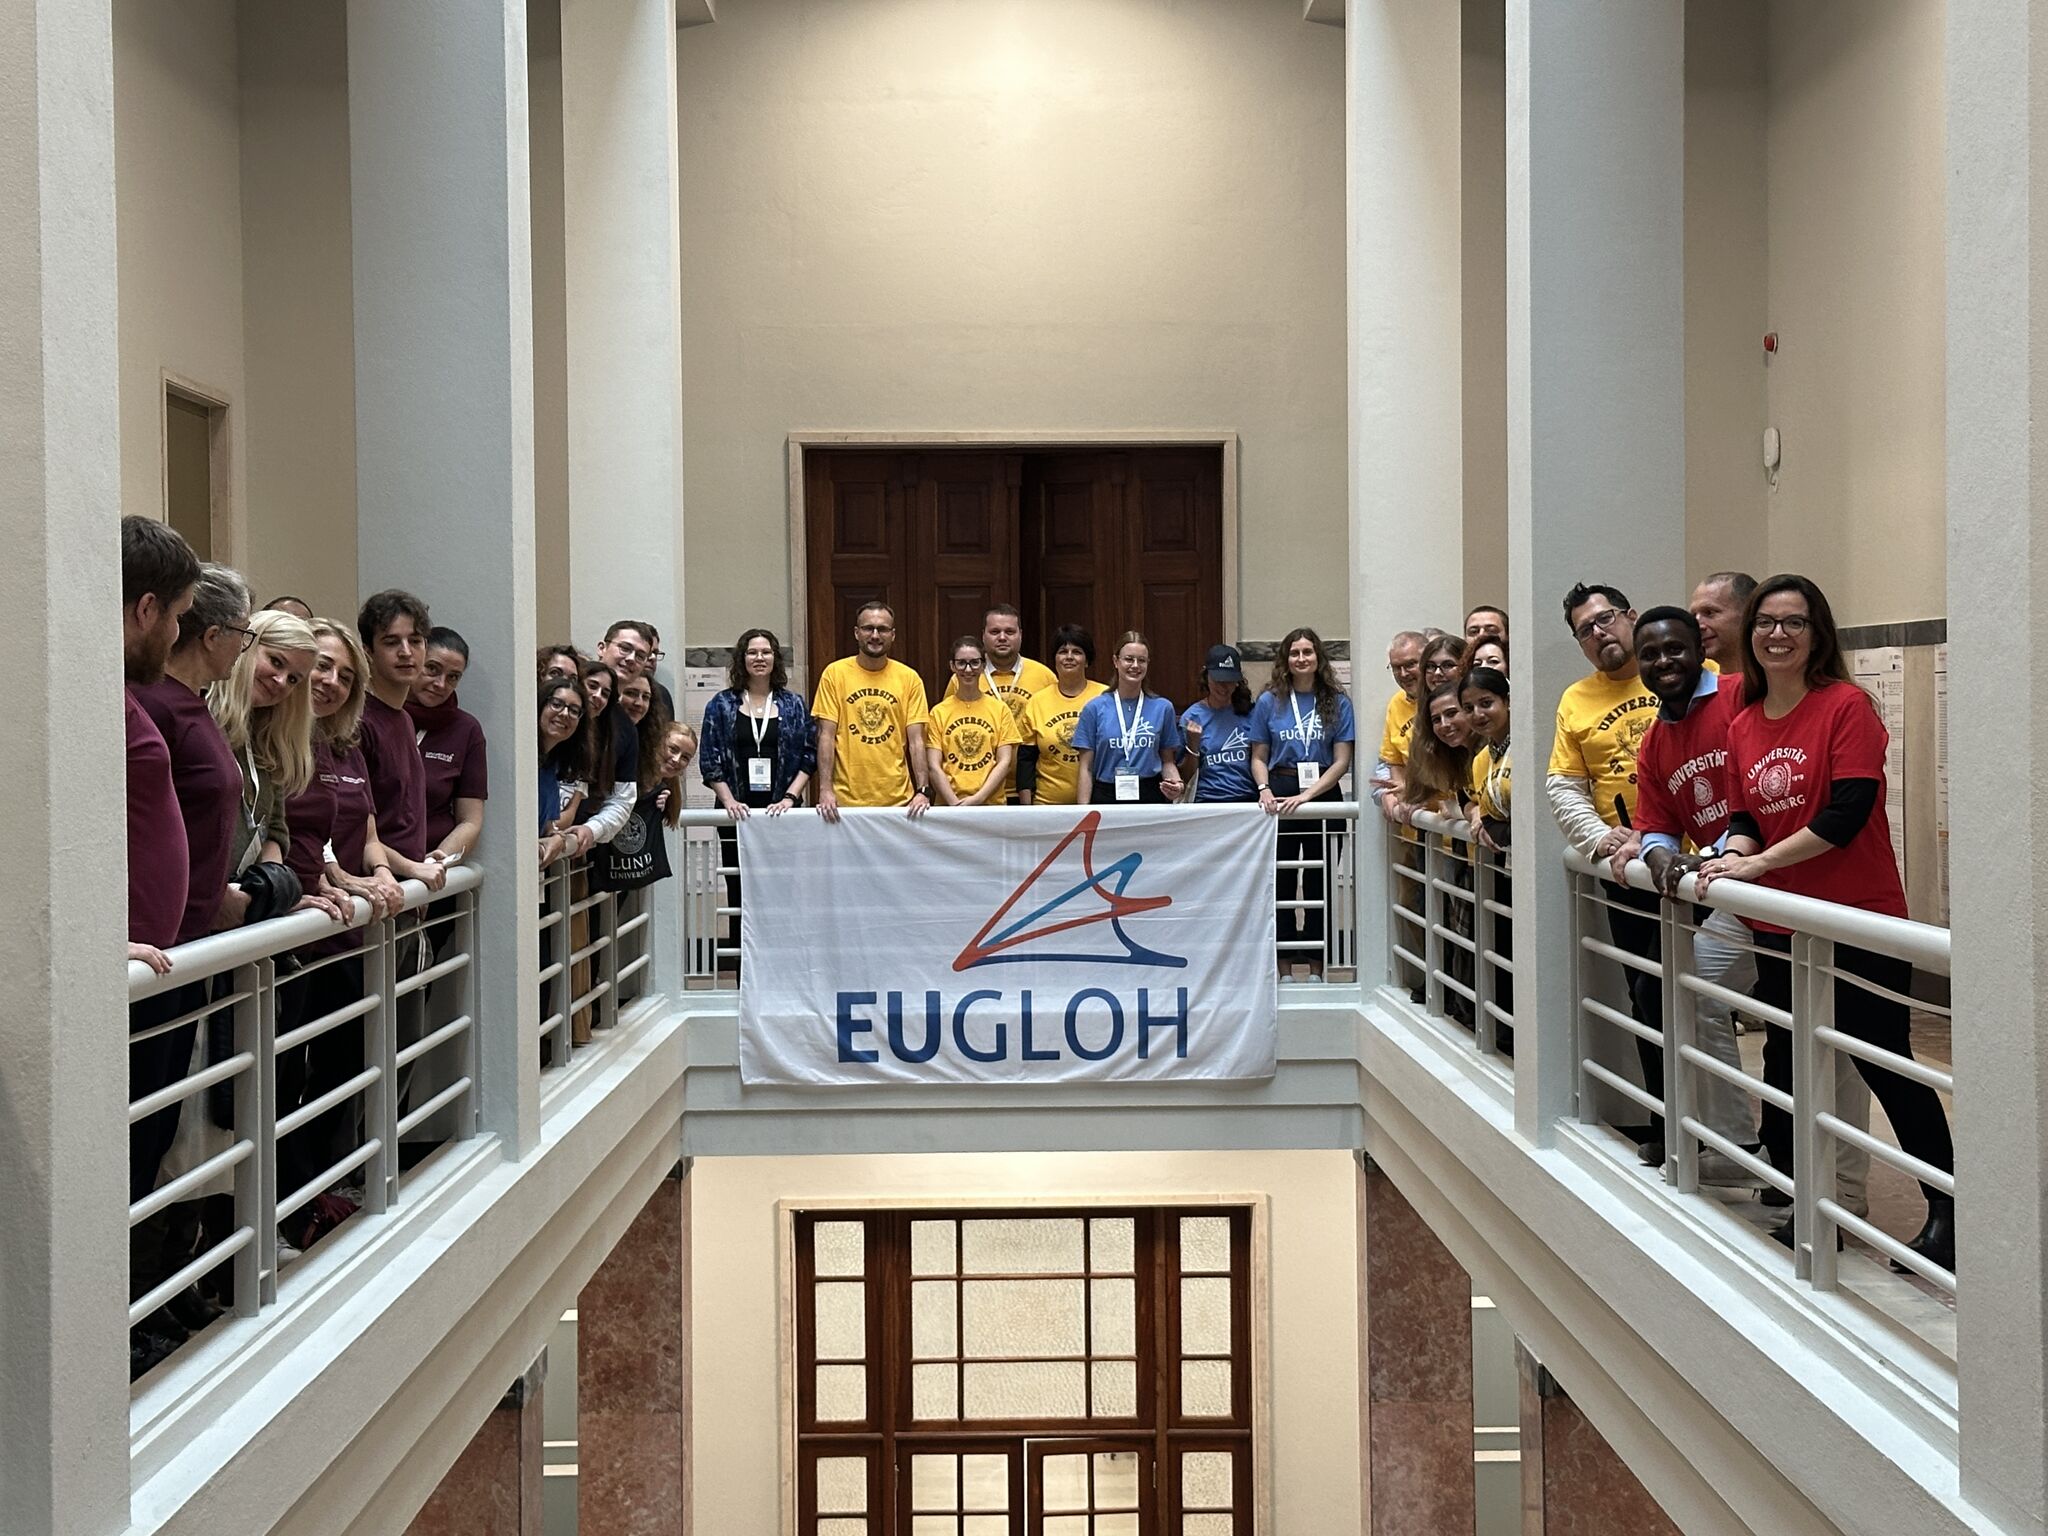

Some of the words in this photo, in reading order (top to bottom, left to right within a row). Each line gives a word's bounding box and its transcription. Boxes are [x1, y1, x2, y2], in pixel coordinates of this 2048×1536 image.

[846, 688, 898, 705] UNIVERSITY
[945, 716, 994, 736] UNIVERSITY
[1045, 711, 1080, 728] UNIVER
[848, 723, 860, 736] OF
[861, 724, 895, 745] SZEGED
[1109, 736, 1156, 749] EULOH
[1280, 729, 1326, 741] EUGOH
[1048, 744, 1061, 756] OF
[1206, 749, 1246, 766] EUGLO
[948, 752, 959, 764] OF
[958, 751, 993, 772] SZEGED
[1747, 747, 1808, 780] UNIVERSITÄT
[1667, 748, 1729, 796] UNIVERSITÄT
[836, 987, 1189, 1063] EUGLOH
